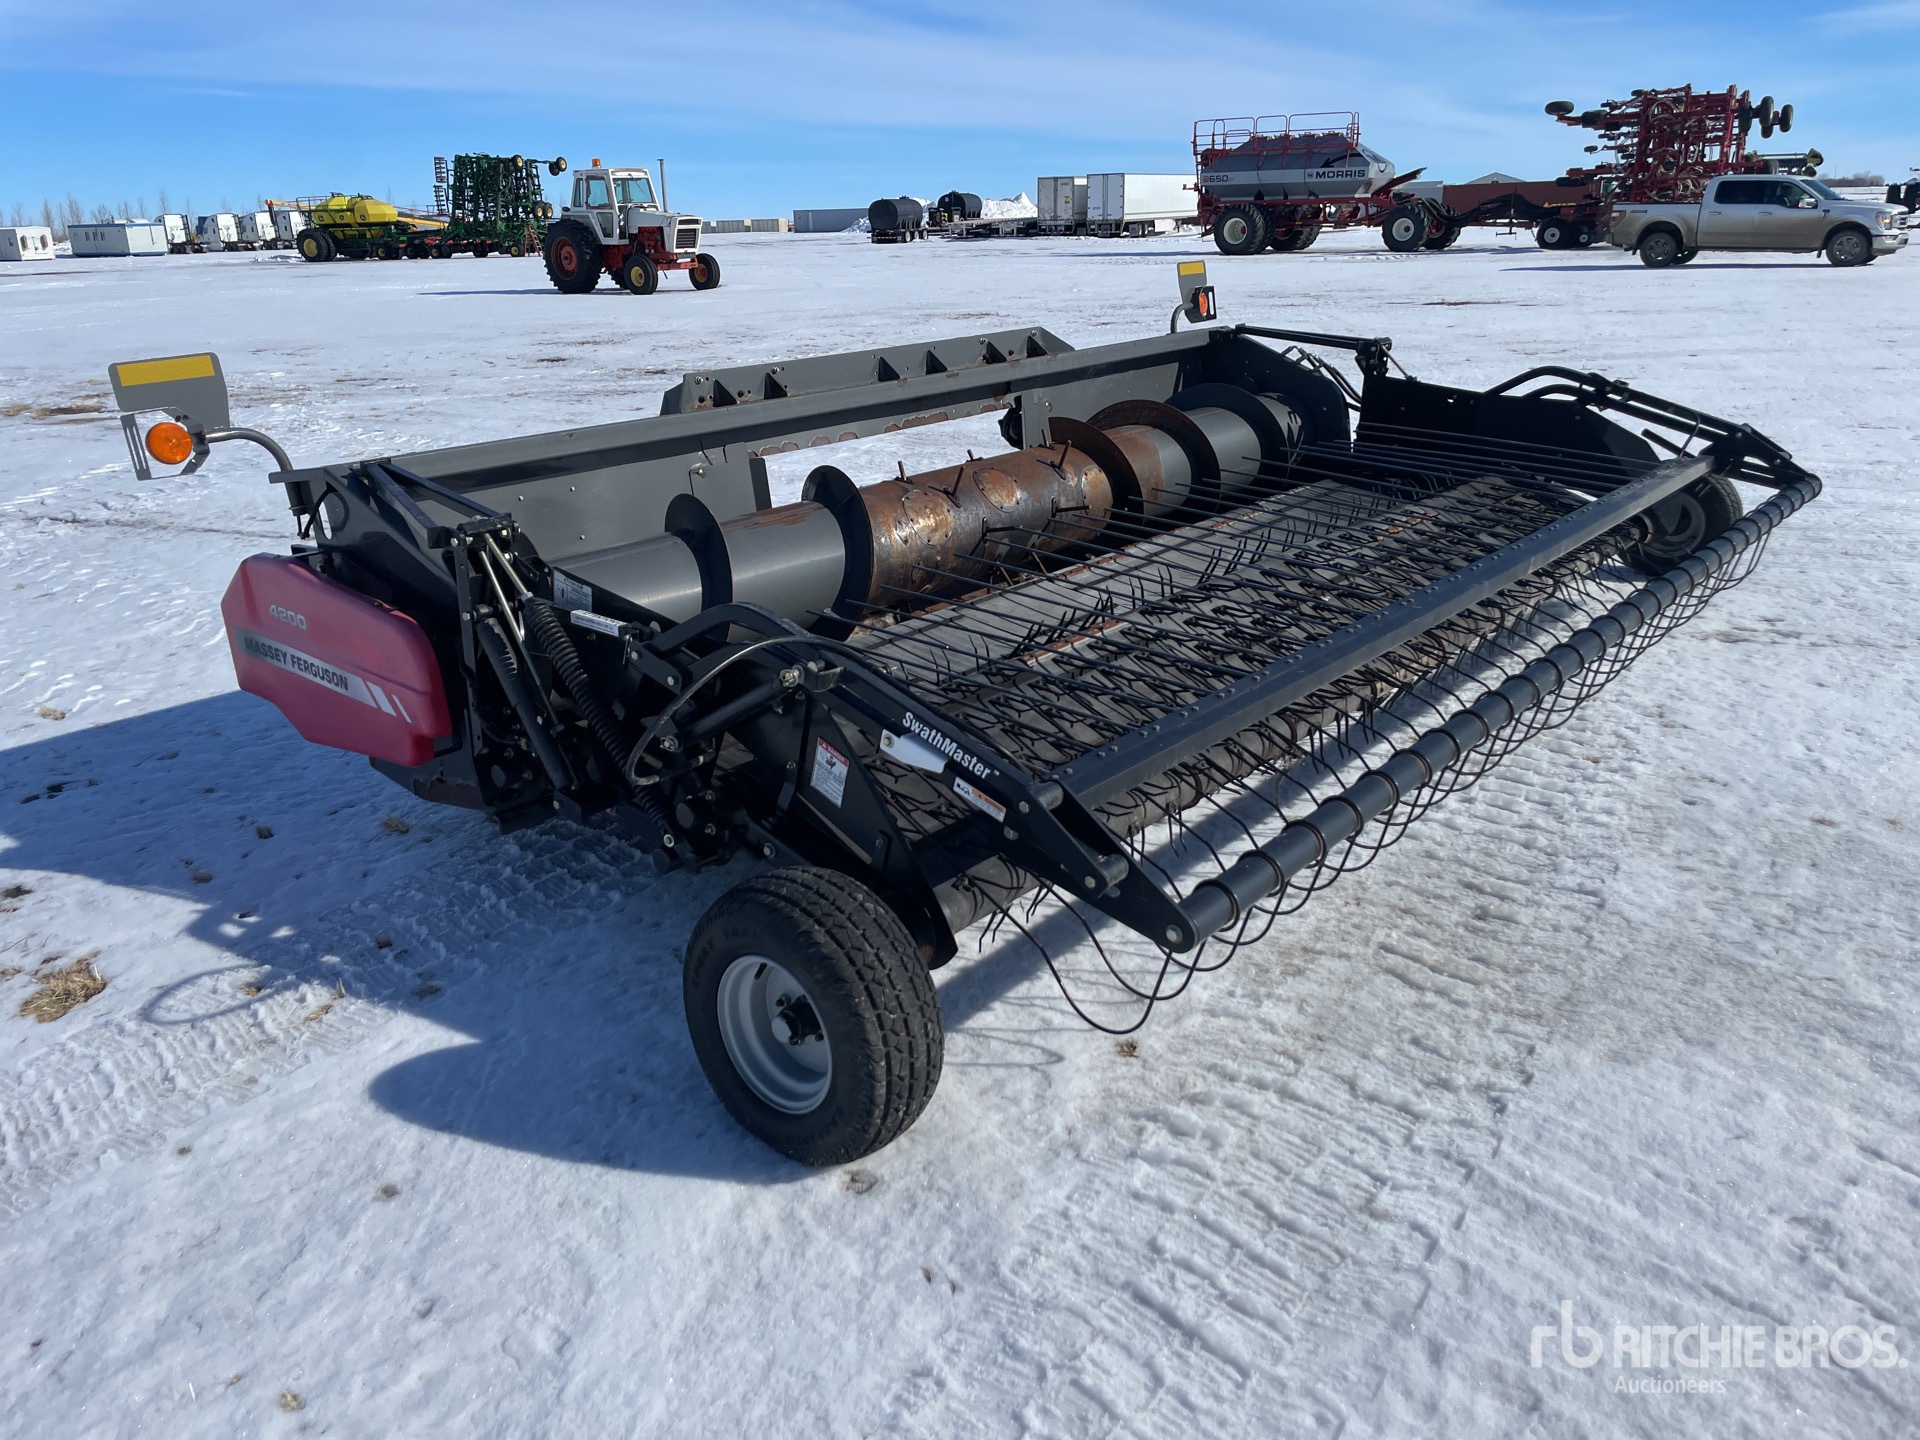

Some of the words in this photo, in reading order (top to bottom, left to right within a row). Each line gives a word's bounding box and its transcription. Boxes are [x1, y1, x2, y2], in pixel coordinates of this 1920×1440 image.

[1315, 169, 1366, 179] MORRIS
[269, 604, 307, 630] 4200
[244, 636, 288, 664] MASSEY
[290, 654, 349, 691] FERGUSON
[902, 711, 991, 779] SwathMaster
